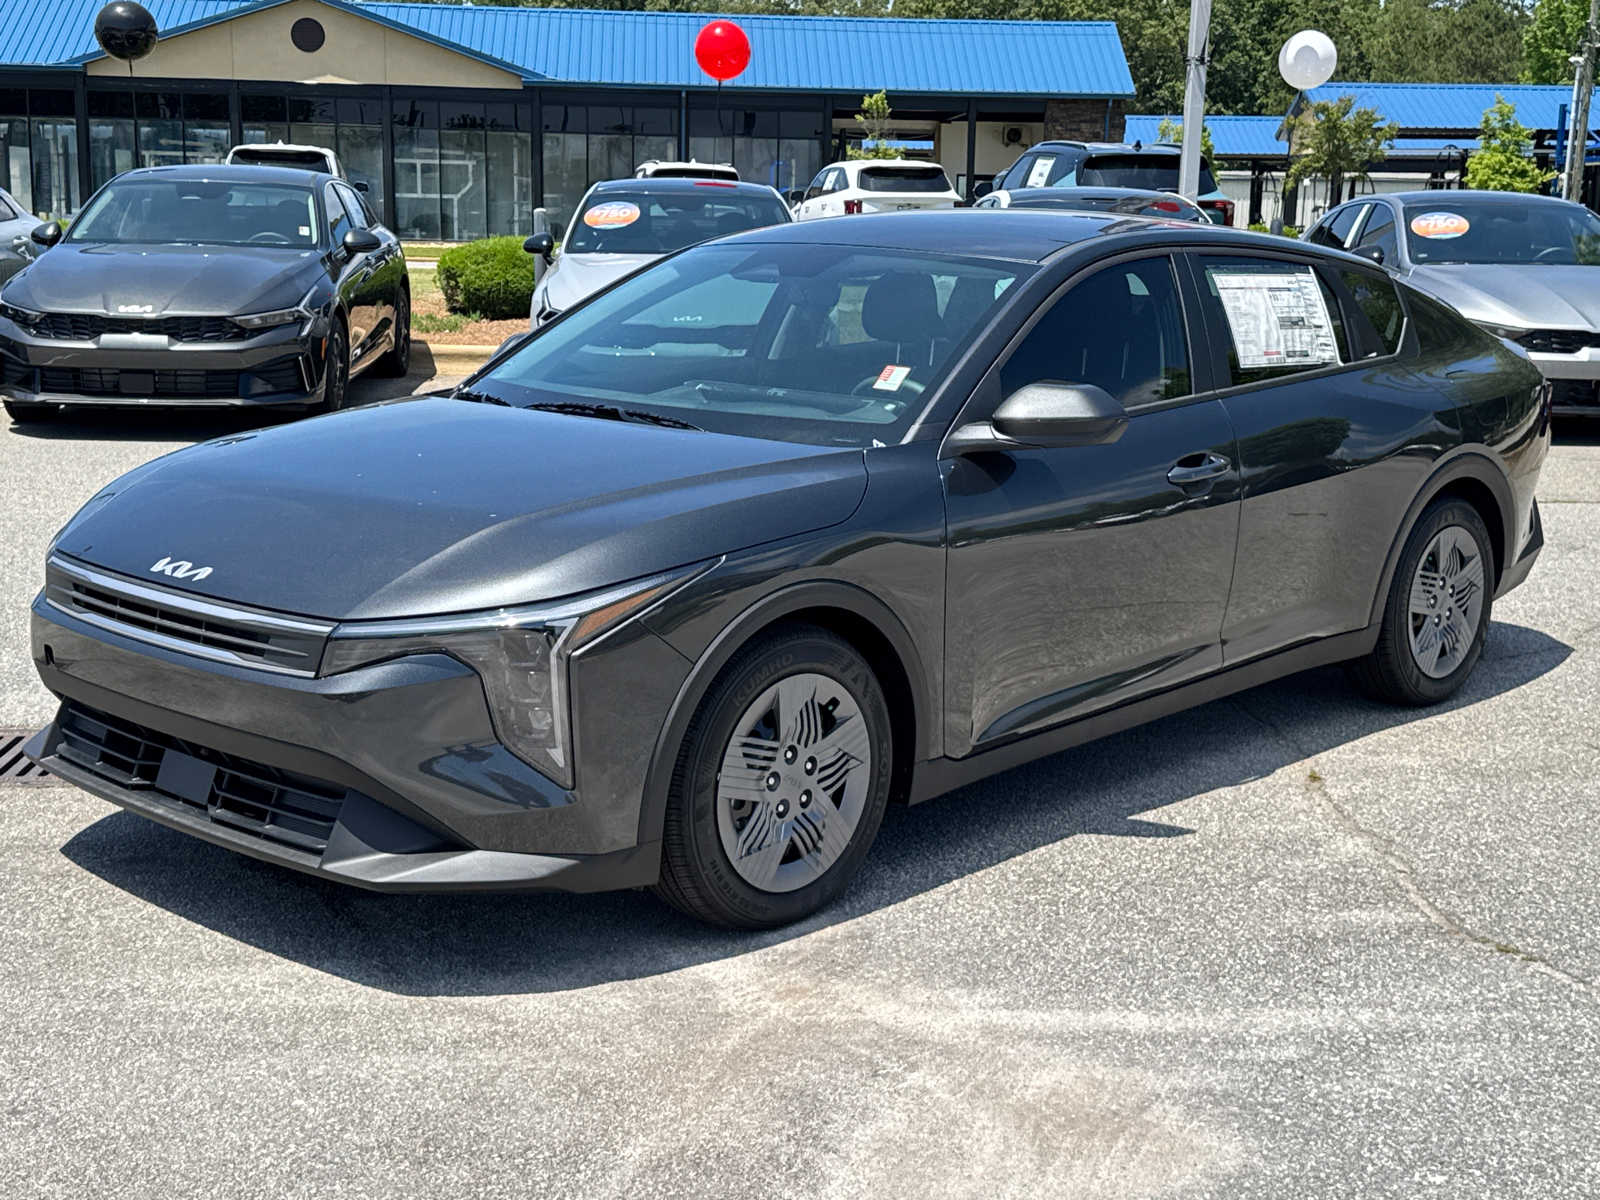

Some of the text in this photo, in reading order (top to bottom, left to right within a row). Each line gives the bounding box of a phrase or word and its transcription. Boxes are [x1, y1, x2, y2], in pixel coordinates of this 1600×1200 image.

[149, 556, 213, 581] KIA
[733, 652, 793, 707] KUMHO
[874, 741, 888, 819] SOLUS
